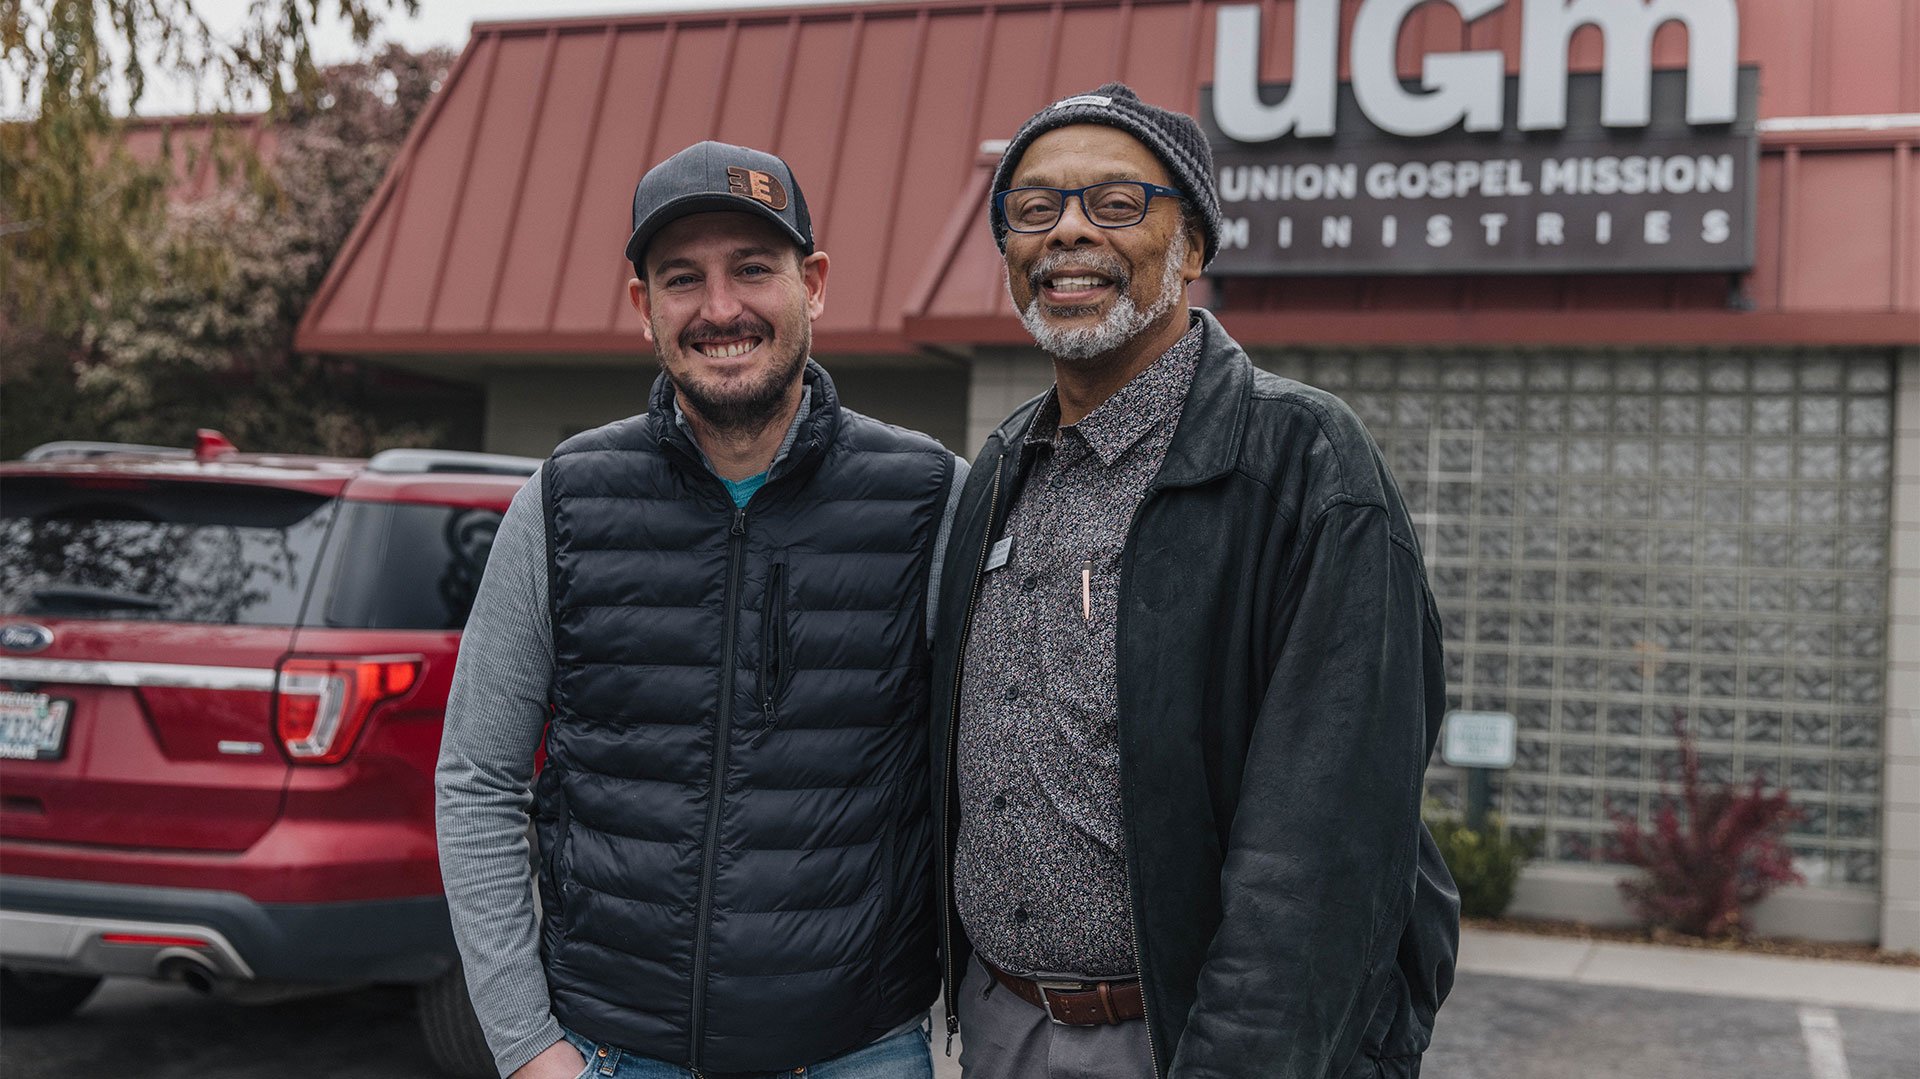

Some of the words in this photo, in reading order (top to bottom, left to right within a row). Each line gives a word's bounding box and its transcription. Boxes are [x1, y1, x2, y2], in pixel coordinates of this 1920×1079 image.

[1219, 164, 1357, 201] UNION
[1365, 159, 1532, 198] GOSPEL
[1541, 153, 1734, 195] MISSION
[1222, 209, 1731, 249] MINISTRIES
